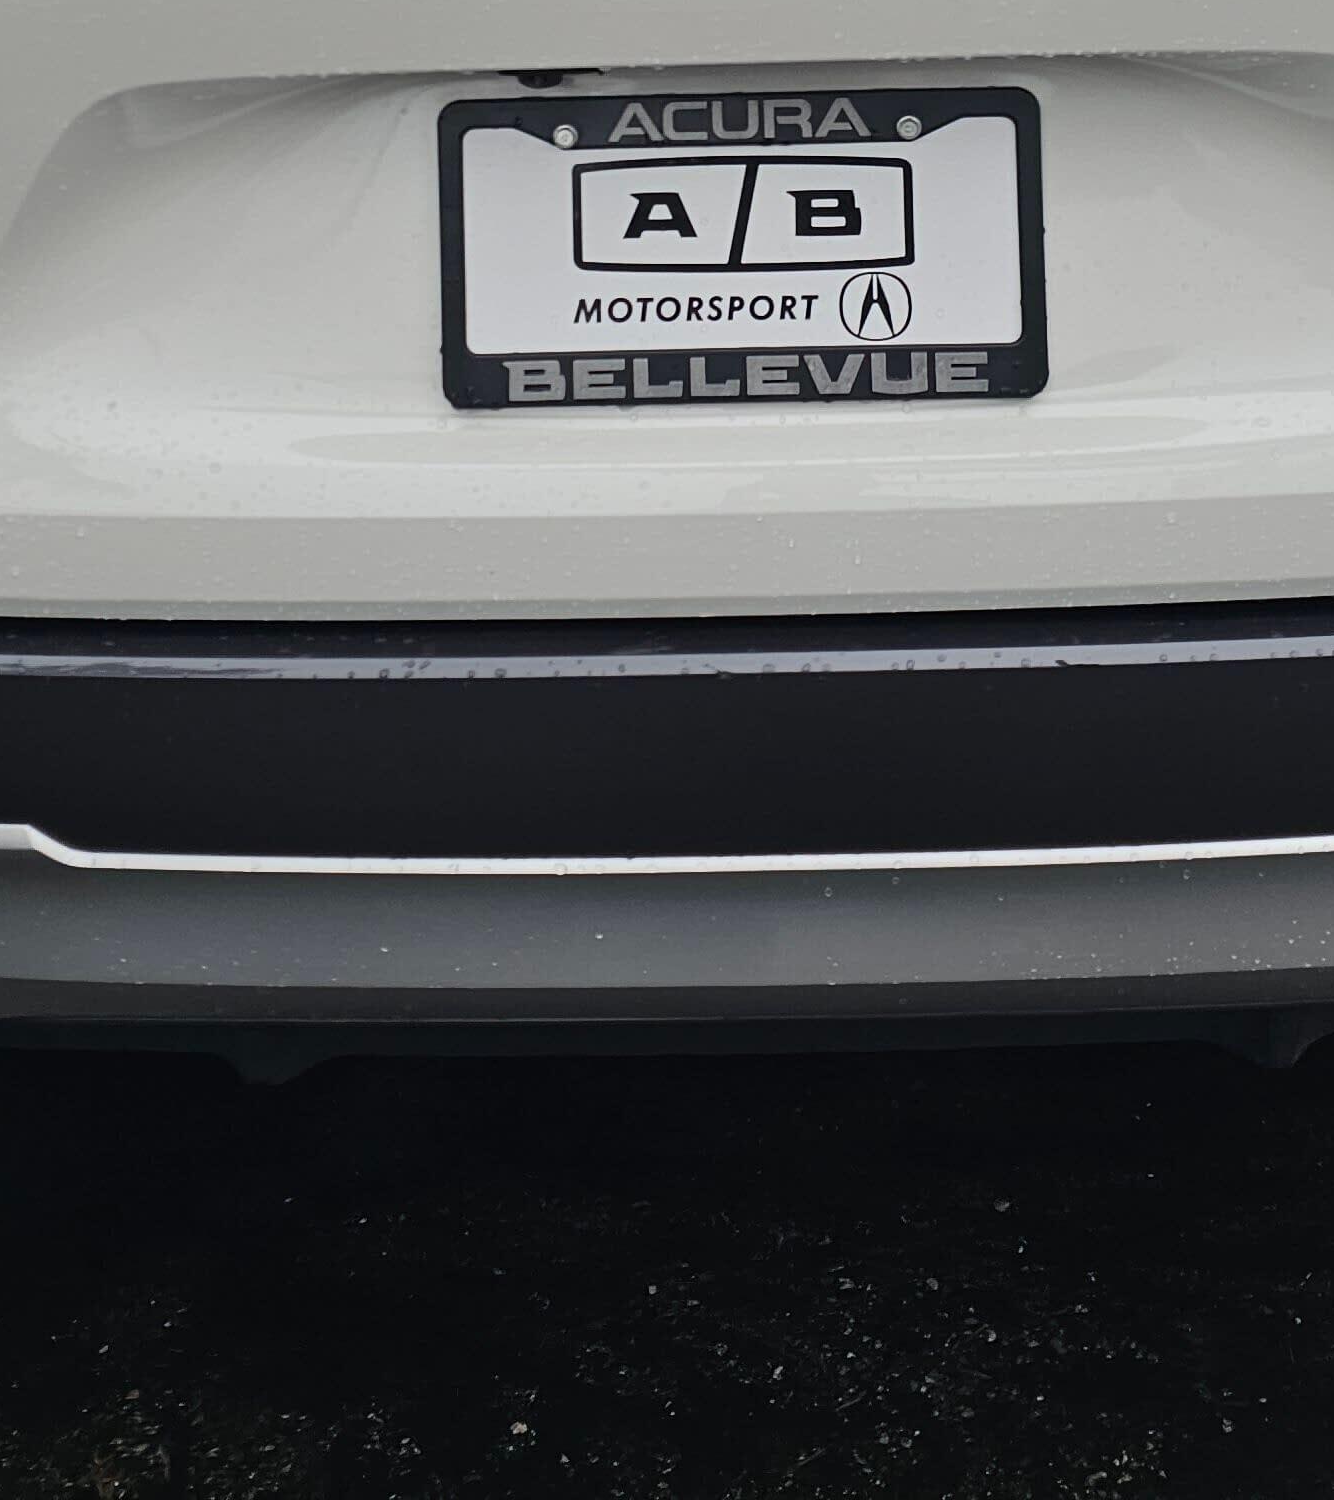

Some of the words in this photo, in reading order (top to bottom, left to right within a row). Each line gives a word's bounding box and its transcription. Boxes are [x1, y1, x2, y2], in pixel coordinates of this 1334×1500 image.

[608, 98, 870, 142] ACURA
[573, 295, 819, 324] MOTORSPORT
[502, 352, 989, 402] BELLEVUE
